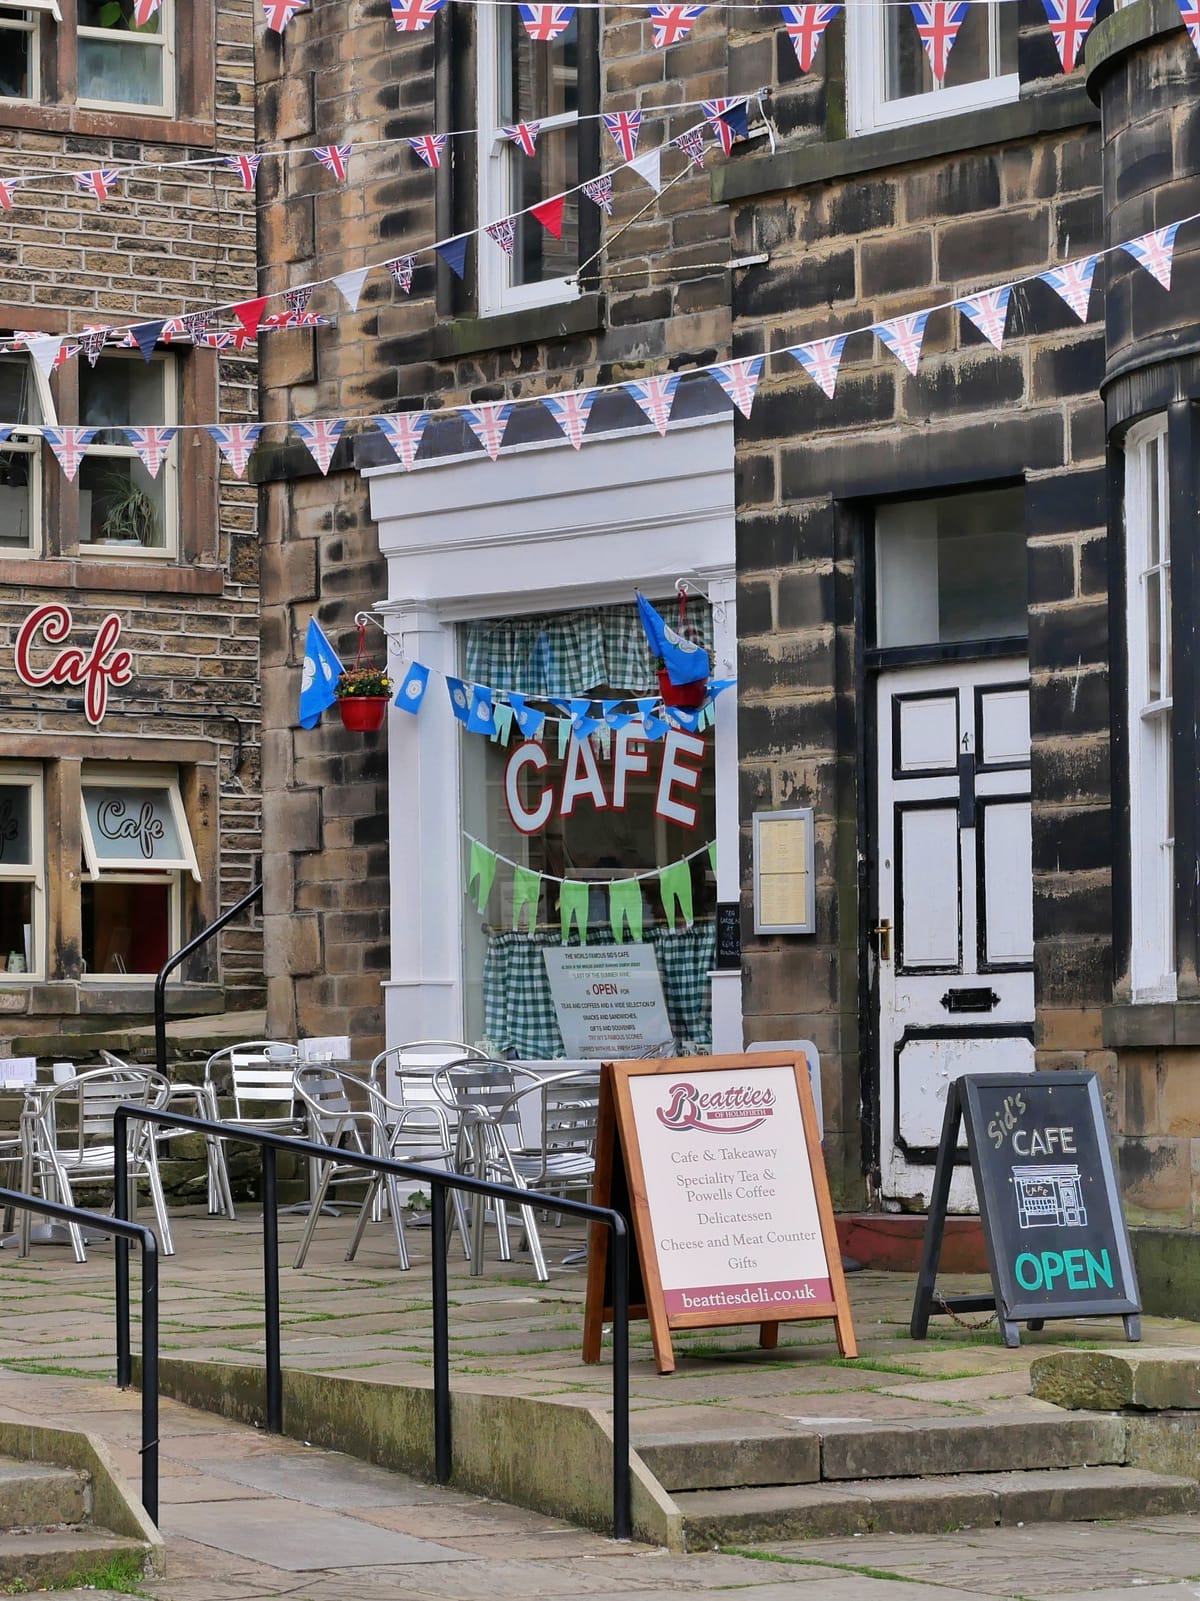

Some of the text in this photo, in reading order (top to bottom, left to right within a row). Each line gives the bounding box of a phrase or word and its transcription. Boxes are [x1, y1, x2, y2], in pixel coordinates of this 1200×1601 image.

[15, 602, 133, 725] Cafe
[961, 731, 969, 751] 4
[504, 719, 706, 835] CAFE
[97, 799, 164, 859] Cafe
[592, 983, 618, 995] OPEN
[656, 1082, 776, 1134] Beatties
[725, 1109, 767, 1118] HOLMFIRTH
[988, 1093, 1027, 1149] Sid's
[1011, 1127, 1077, 1157] CAFE
[671, 1147, 777, 1164] Cafe & Takeaway
[676, 1168, 776, 1187] Speciality Tea &
[686, 1186, 776, 1203] Powells Coffee
[1026, 1184, 1049, 1197] CAFE
[697, 1210, 772, 1225] Delicatessen
[660, 1231, 817, 1251] Cheese and Meat Counter
[728, 1257, 758, 1270] Gifts
[1015, 1248, 1114, 1291] OPEN
[681, 1284, 816, 1308] beattiesdeli.co.uk
